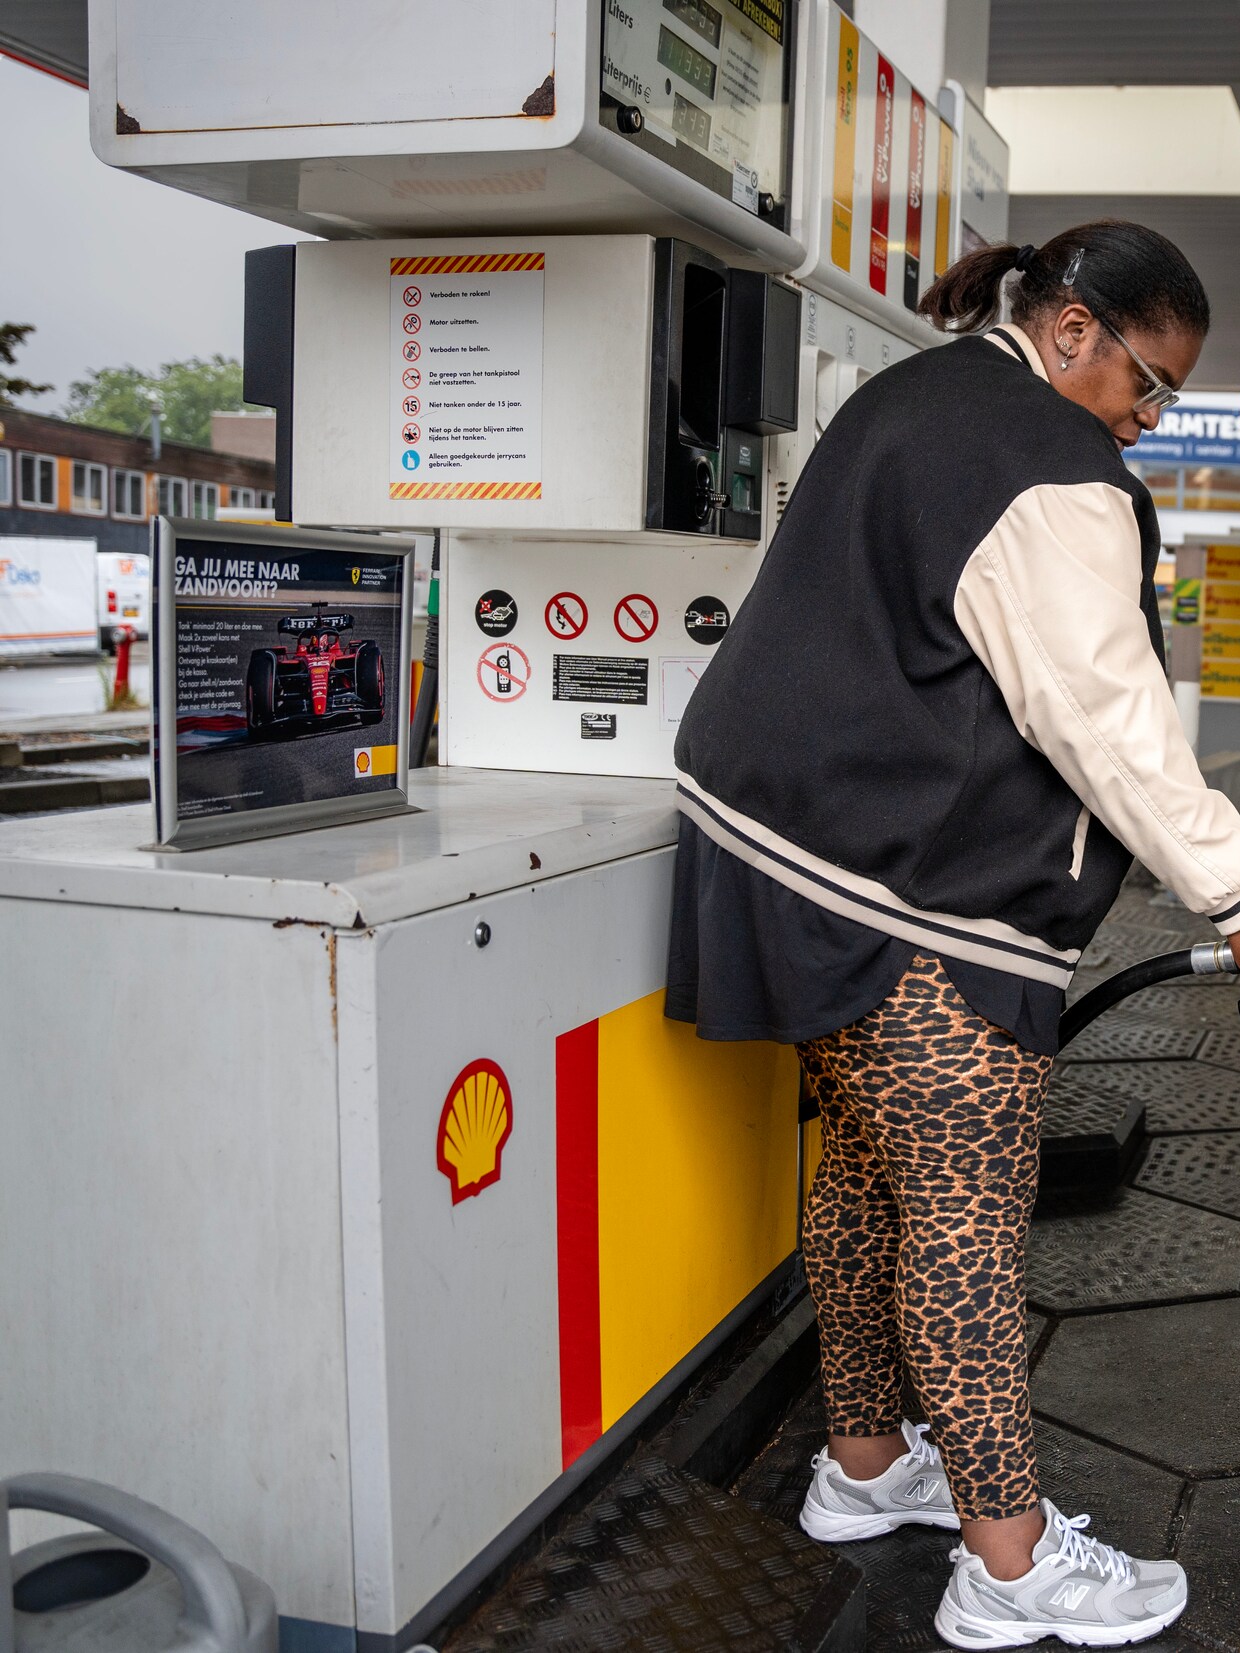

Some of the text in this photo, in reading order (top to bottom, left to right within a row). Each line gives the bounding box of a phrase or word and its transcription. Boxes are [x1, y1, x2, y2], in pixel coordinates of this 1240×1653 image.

[608, 0, 633, 29] Liters
[603, 56, 642, 98] Literprijs
[484, 370, 520, 378] tankpistool
[405, 401, 417, 412] 15
[483, 426, 505, 434] blijven
[450, 453, 495, 461] goedgekeurde
[176, 556, 299, 581] GA JIJ MEE NAAR
[175, 577, 278, 598] ZANDVOORT?
[242, 622, 251, 630] doe
[179, 645, 190, 653] Shell
[179, 657, 200, 666] Ontvang
[179, 680, 187, 688] Ga
[179, 691, 193, 699] check
[194, 692, 198, 700] je
[216, 689, 227, 697] code
[179, 703, 188, 711] doe
[211, 701, 217, 709] de
[904, 1477, 940, 1502] N
[1050, 1582, 1091, 1611] N
